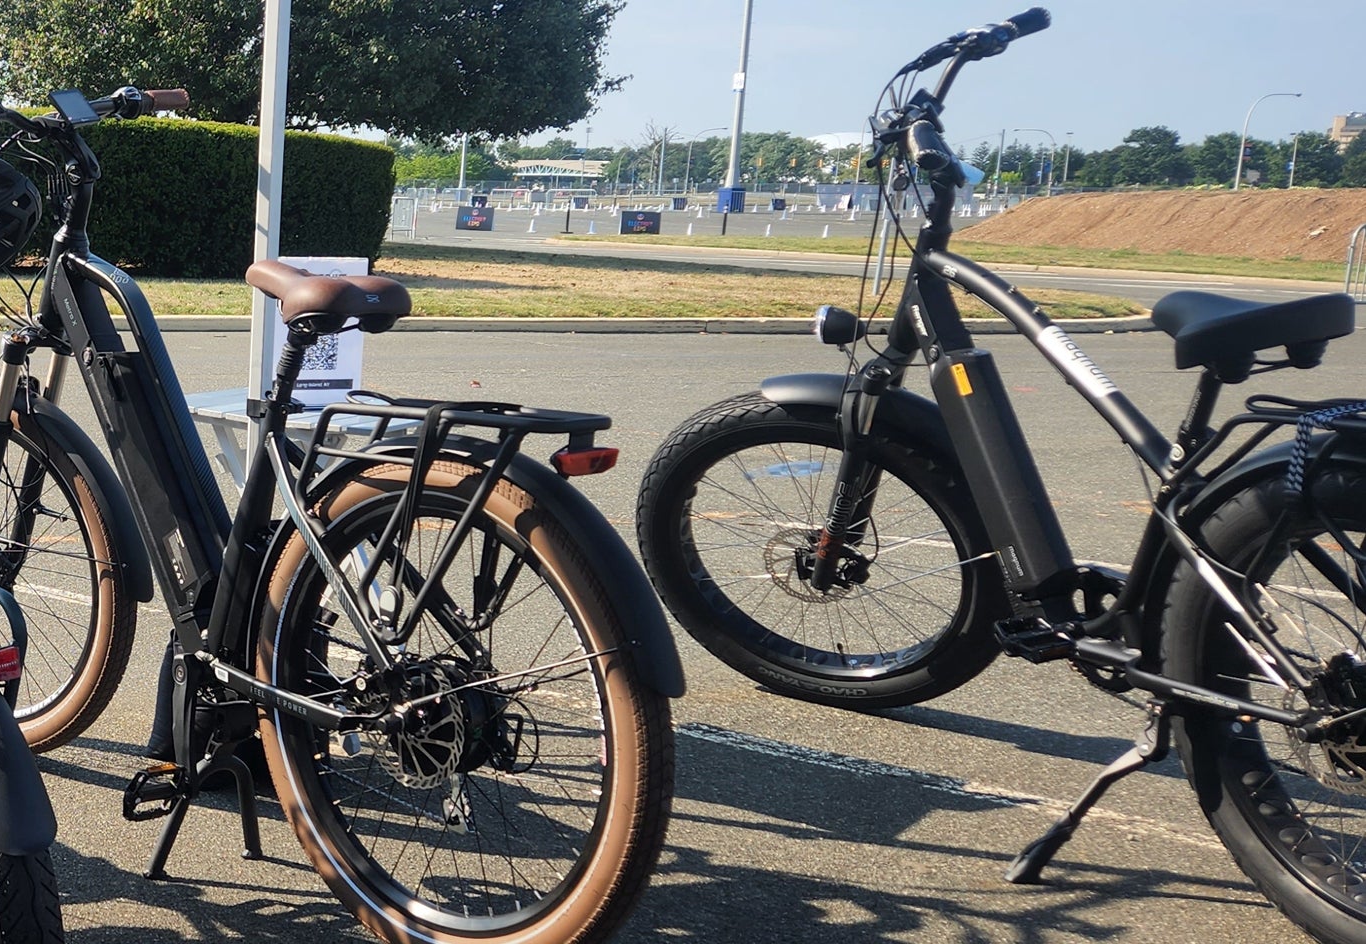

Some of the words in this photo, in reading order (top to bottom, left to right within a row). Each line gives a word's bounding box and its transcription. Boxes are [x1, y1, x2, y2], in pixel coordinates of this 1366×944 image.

[64, 298, 74, 320] Metro
[911, 304, 929, 337] Ranger
[1051, 329, 1118, 390] magnum
[1008, 545, 1024, 577] magnum
[250, 685, 265, 699] FEEL
[283, 700, 308, 716] POWER
[819, 685, 868, 696] CHAO
